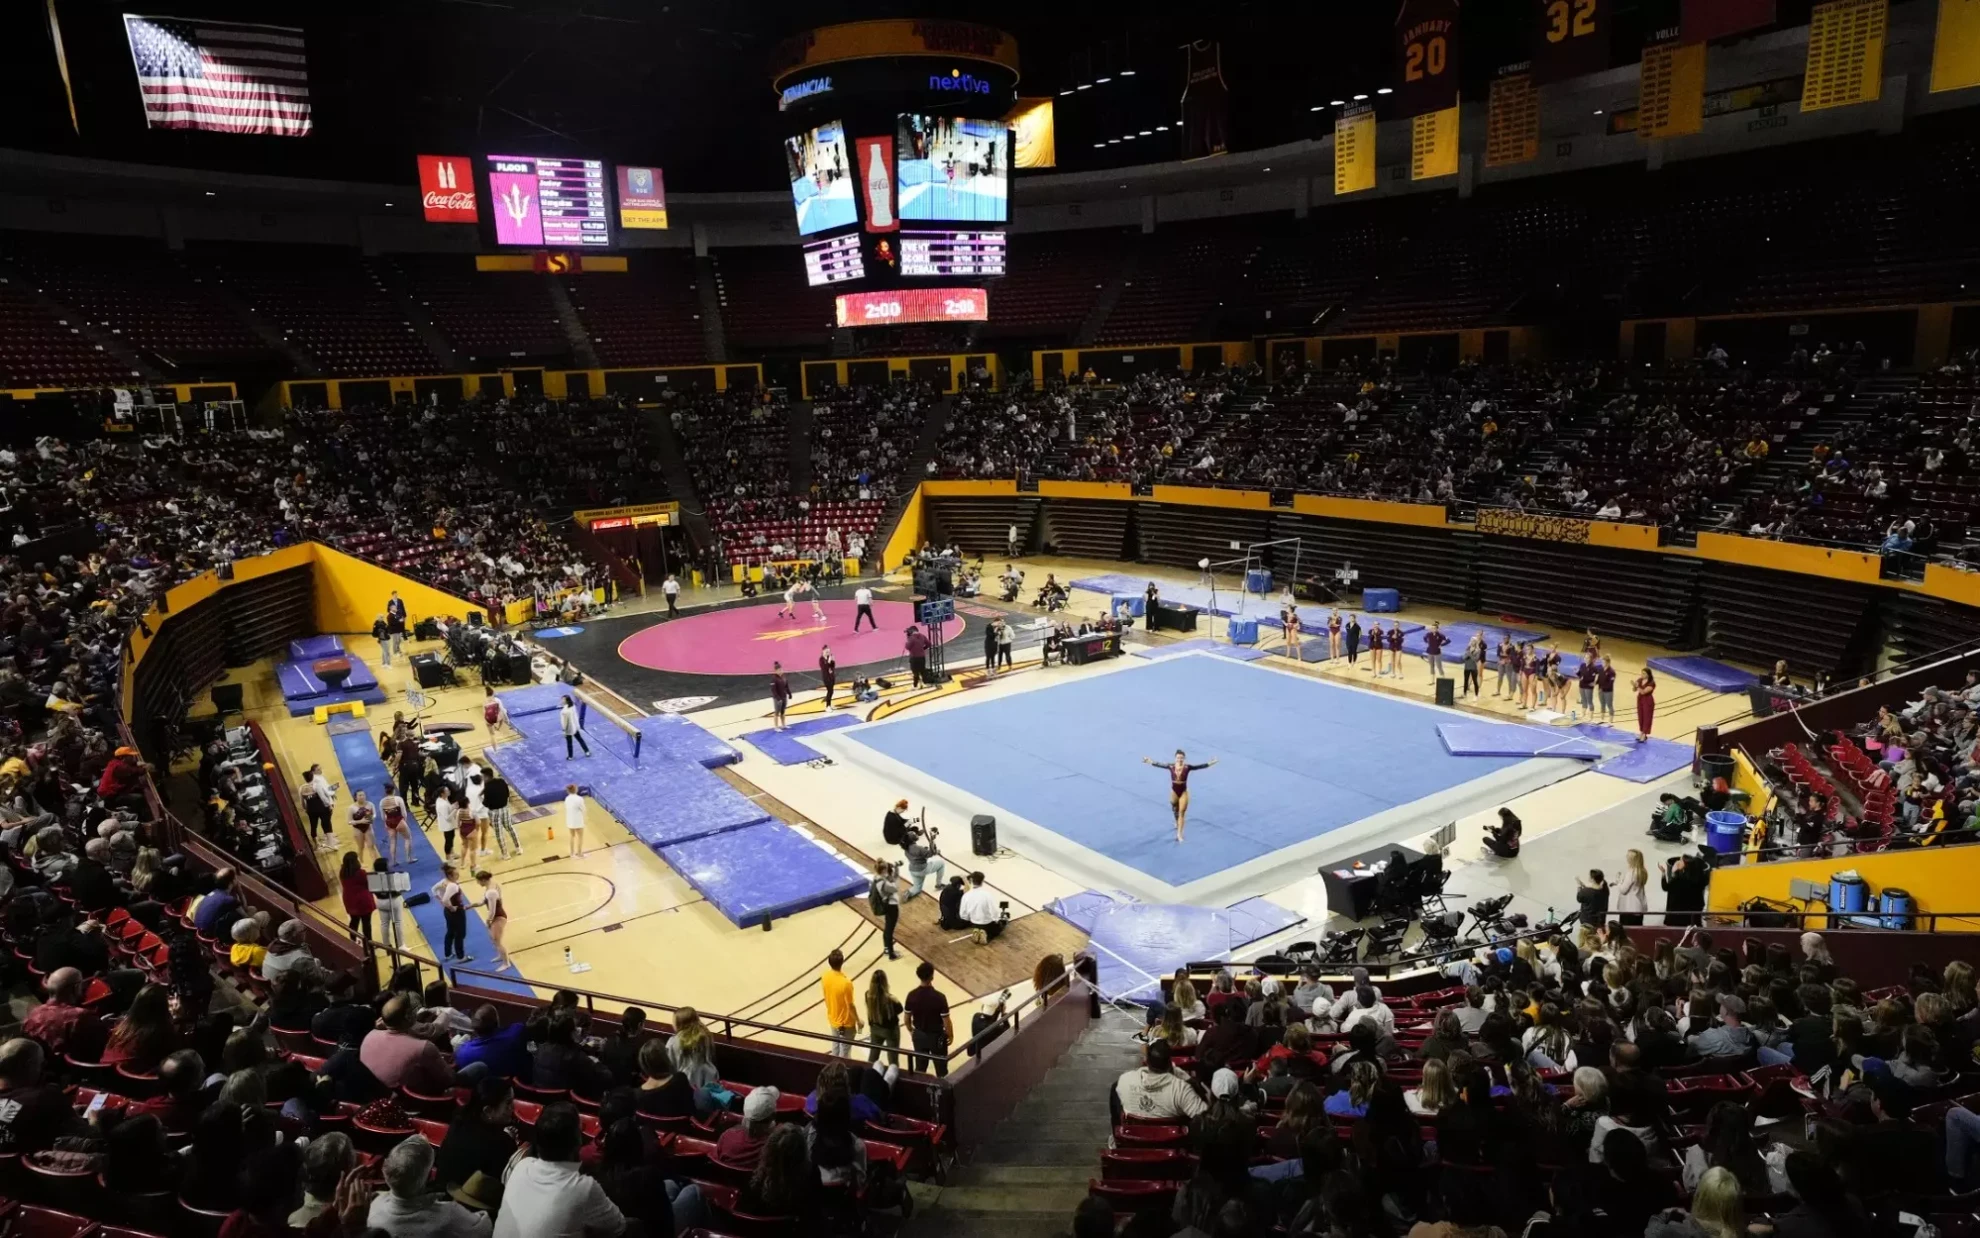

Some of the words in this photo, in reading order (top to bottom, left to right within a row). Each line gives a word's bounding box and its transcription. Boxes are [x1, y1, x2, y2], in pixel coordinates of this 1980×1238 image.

[1546, 0, 1596, 43] 32
[1403, 19, 1452, 46] JANUARY
[1405, 36, 1446, 82] 20
[929, 74, 990, 95] nextiva
[496, 163, 528, 173] FLOOR
[423, 191, 476, 211] Coca-Cola
[865, 302, 901, 318] 2:00
